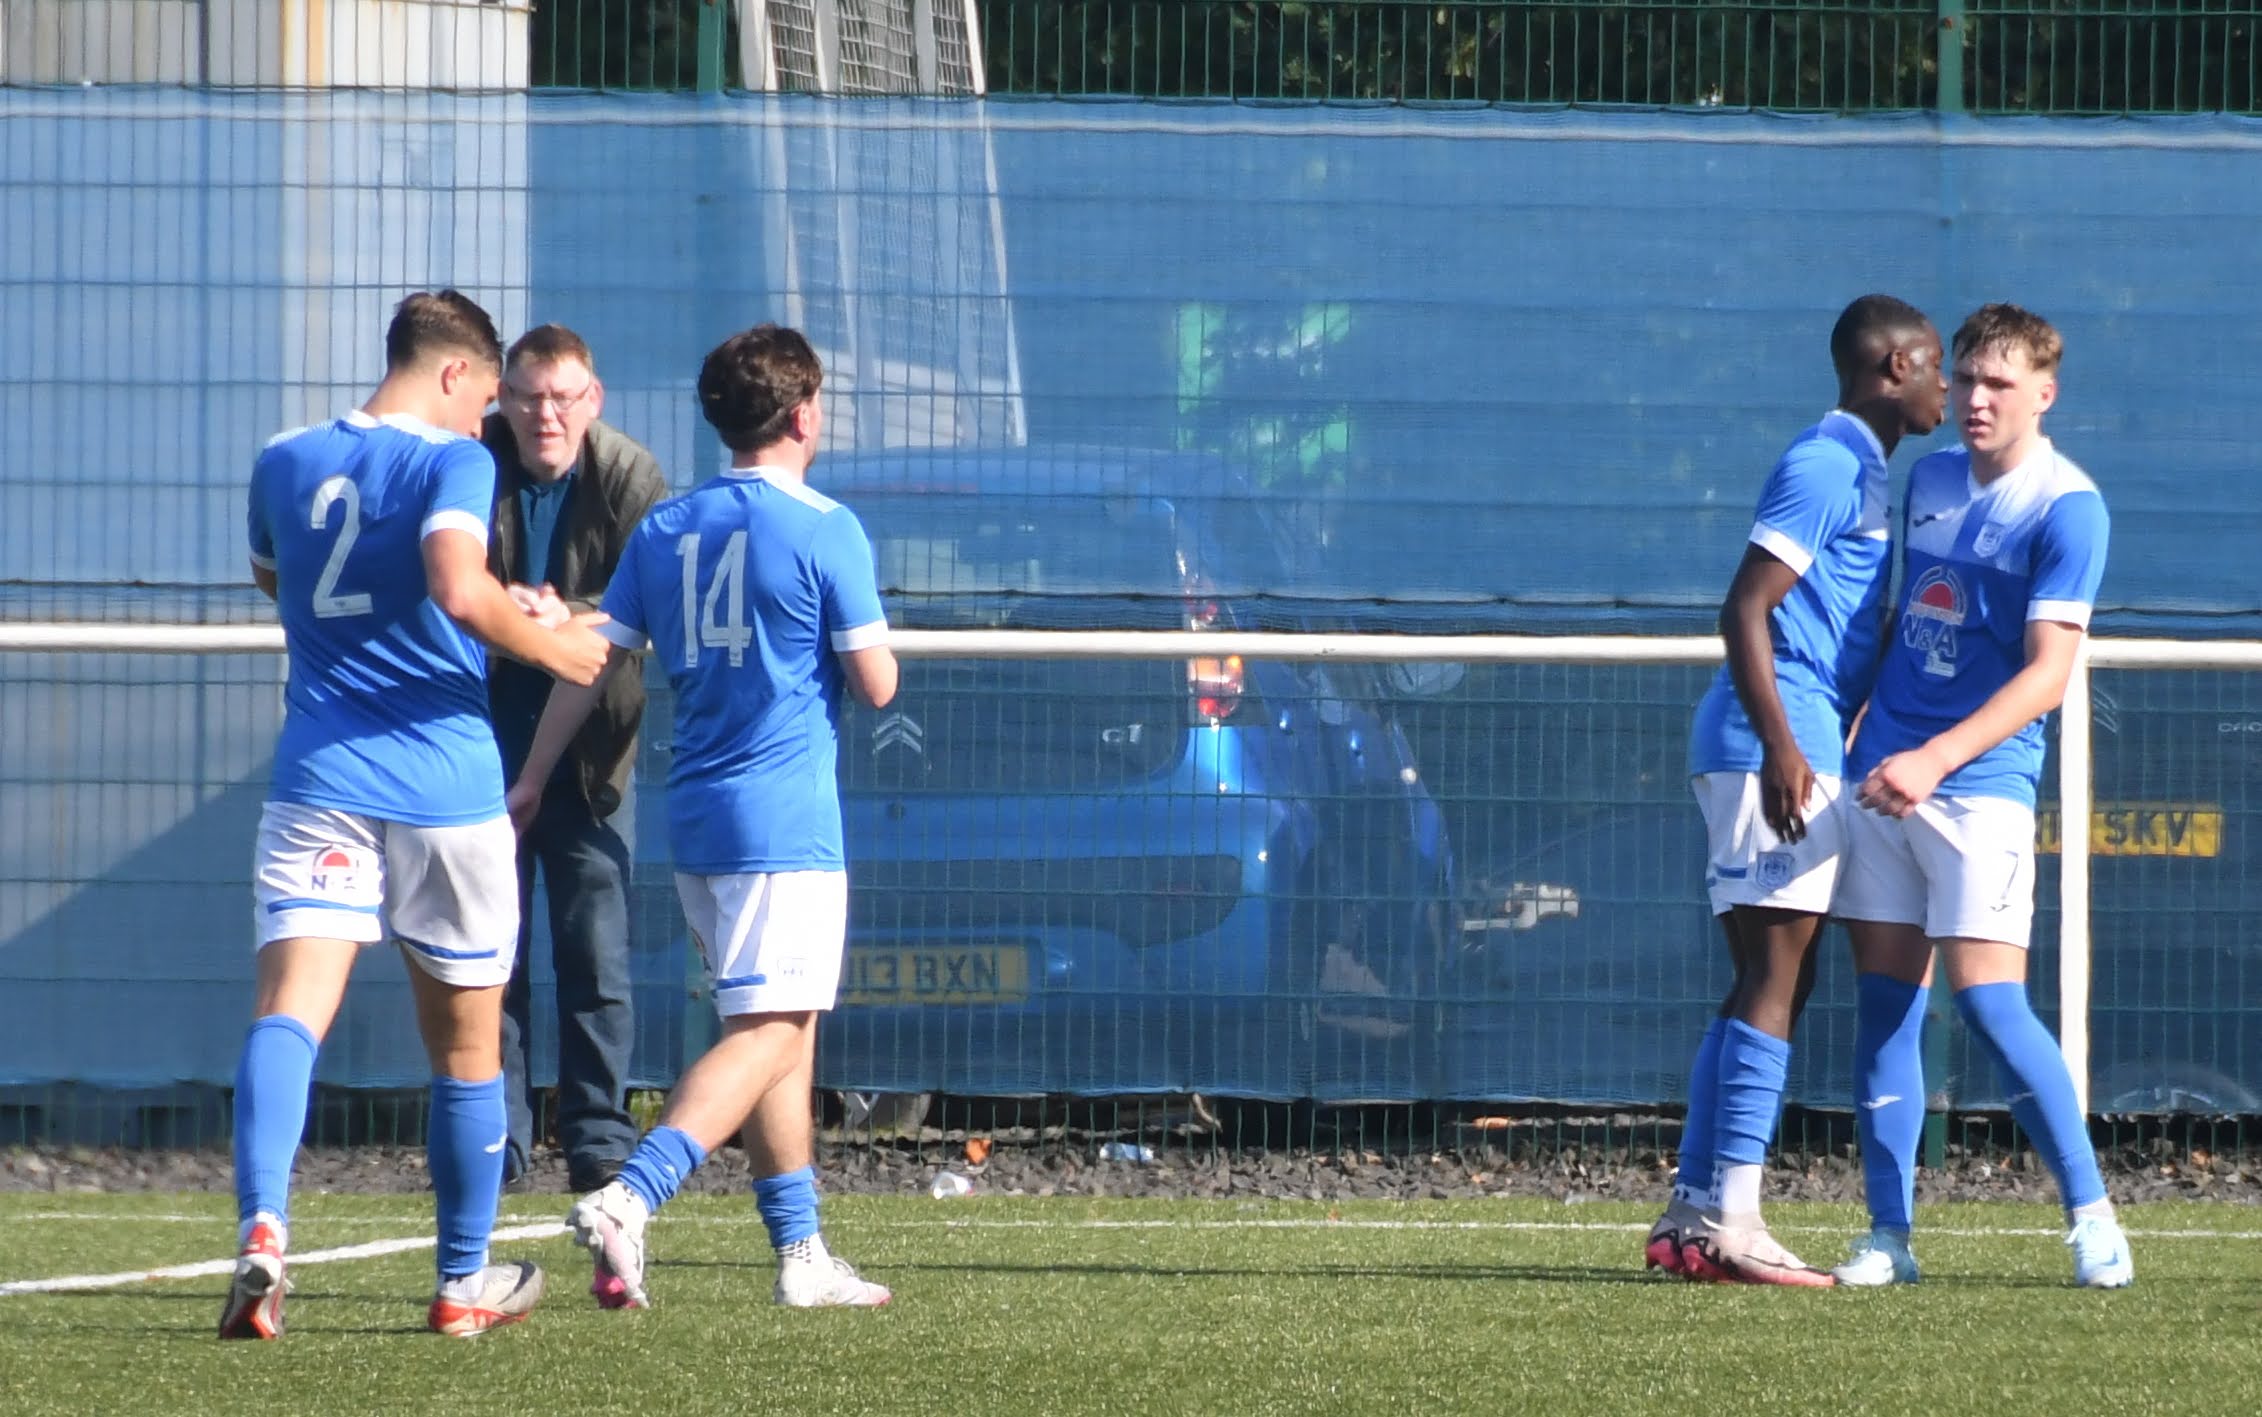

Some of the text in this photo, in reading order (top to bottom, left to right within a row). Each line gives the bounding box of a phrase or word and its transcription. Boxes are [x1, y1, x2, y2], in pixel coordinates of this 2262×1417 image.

[311, 476, 374, 619] 2
[675, 530, 753, 668] 14
[2103, 809, 2190, 848] SKV
[912, 953, 998, 994] BXN
